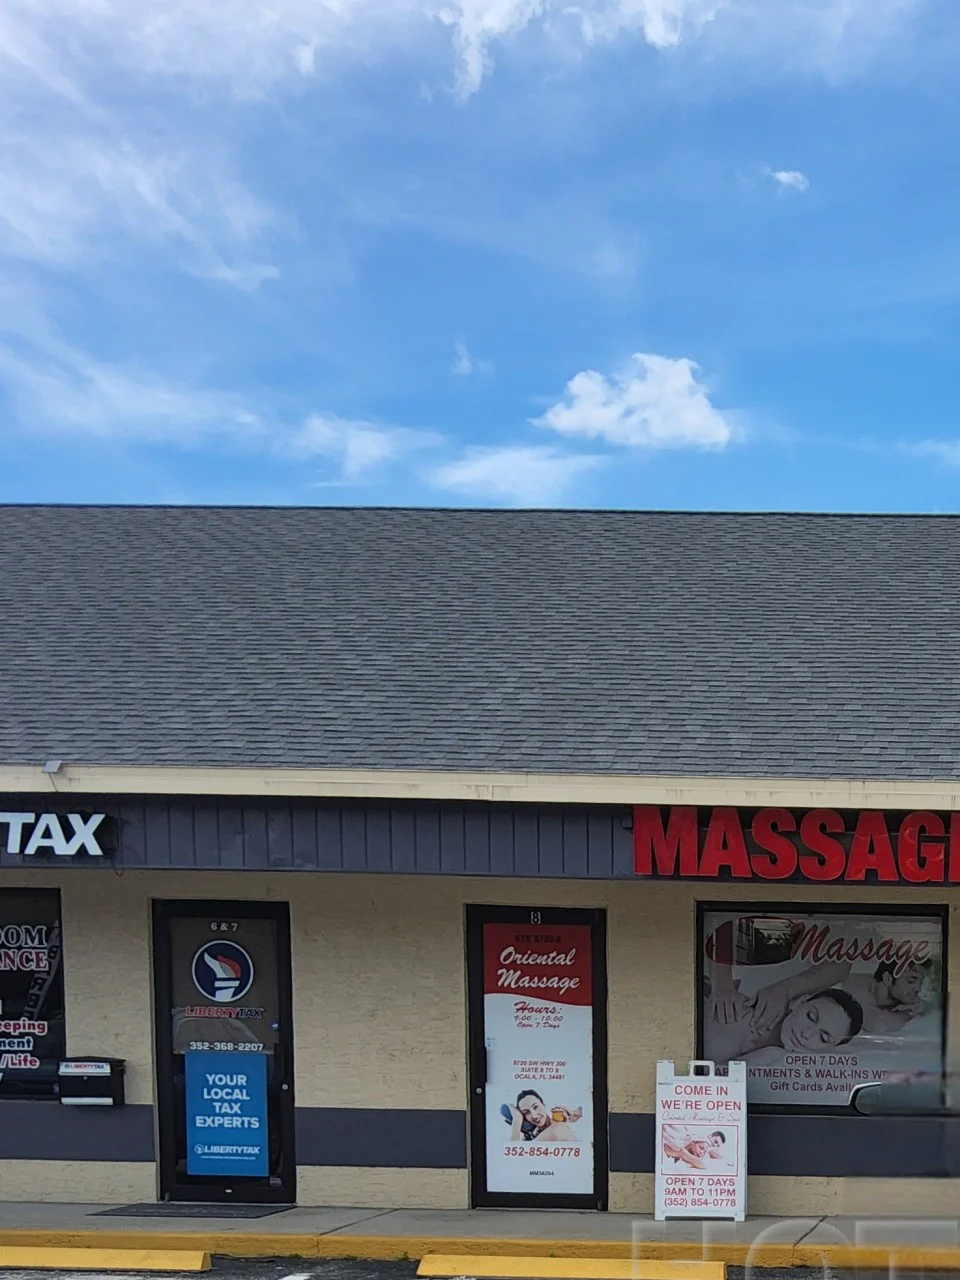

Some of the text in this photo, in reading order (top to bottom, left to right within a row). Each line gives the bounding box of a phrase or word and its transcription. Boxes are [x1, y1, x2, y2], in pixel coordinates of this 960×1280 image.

[0, 812, 106, 856] TAX
[530, 911, 541, 924] 8
[210, 922, 238, 931] 6 & 7
[0, 925, 47, 947] OM
[789, 921, 933, 978] Massage
[0, 949, 49, 971] NCE
[500, 946, 576, 966] Oriental
[497, 968, 581, 995] Massage
[513, 1001, 562, 1014] Hours:
[190, 1041, 264, 1051] 352-368-2207
[785, 1056, 858, 1066] OPEN 7 DAYS
[804, 1068, 812, 1078] &
[815, 1069, 869, 1079] WALK-INS
[205, 1074, 247, 1086] YOUR
[674, 1085, 729, 1096] COME IN
[770, 1082, 789, 1091] Gift
[792, 1082, 823, 1092] Cards
[203, 1088, 250, 1100] LOCAL
[213, 1102, 241, 1114] TAX
[660, 1099, 742, 1111] WE'RE OPEN
[195, 1116, 260, 1128] EXPERTS
[504, 1146, 581, 1157] 352-854-0778
[665, 1177, 735, 1187] OPEN 7 DAYS
[664, 1187, 736, 1197] 9AM TO 11PM
[664, 1197, 736, 1208] (352) 854-0778
